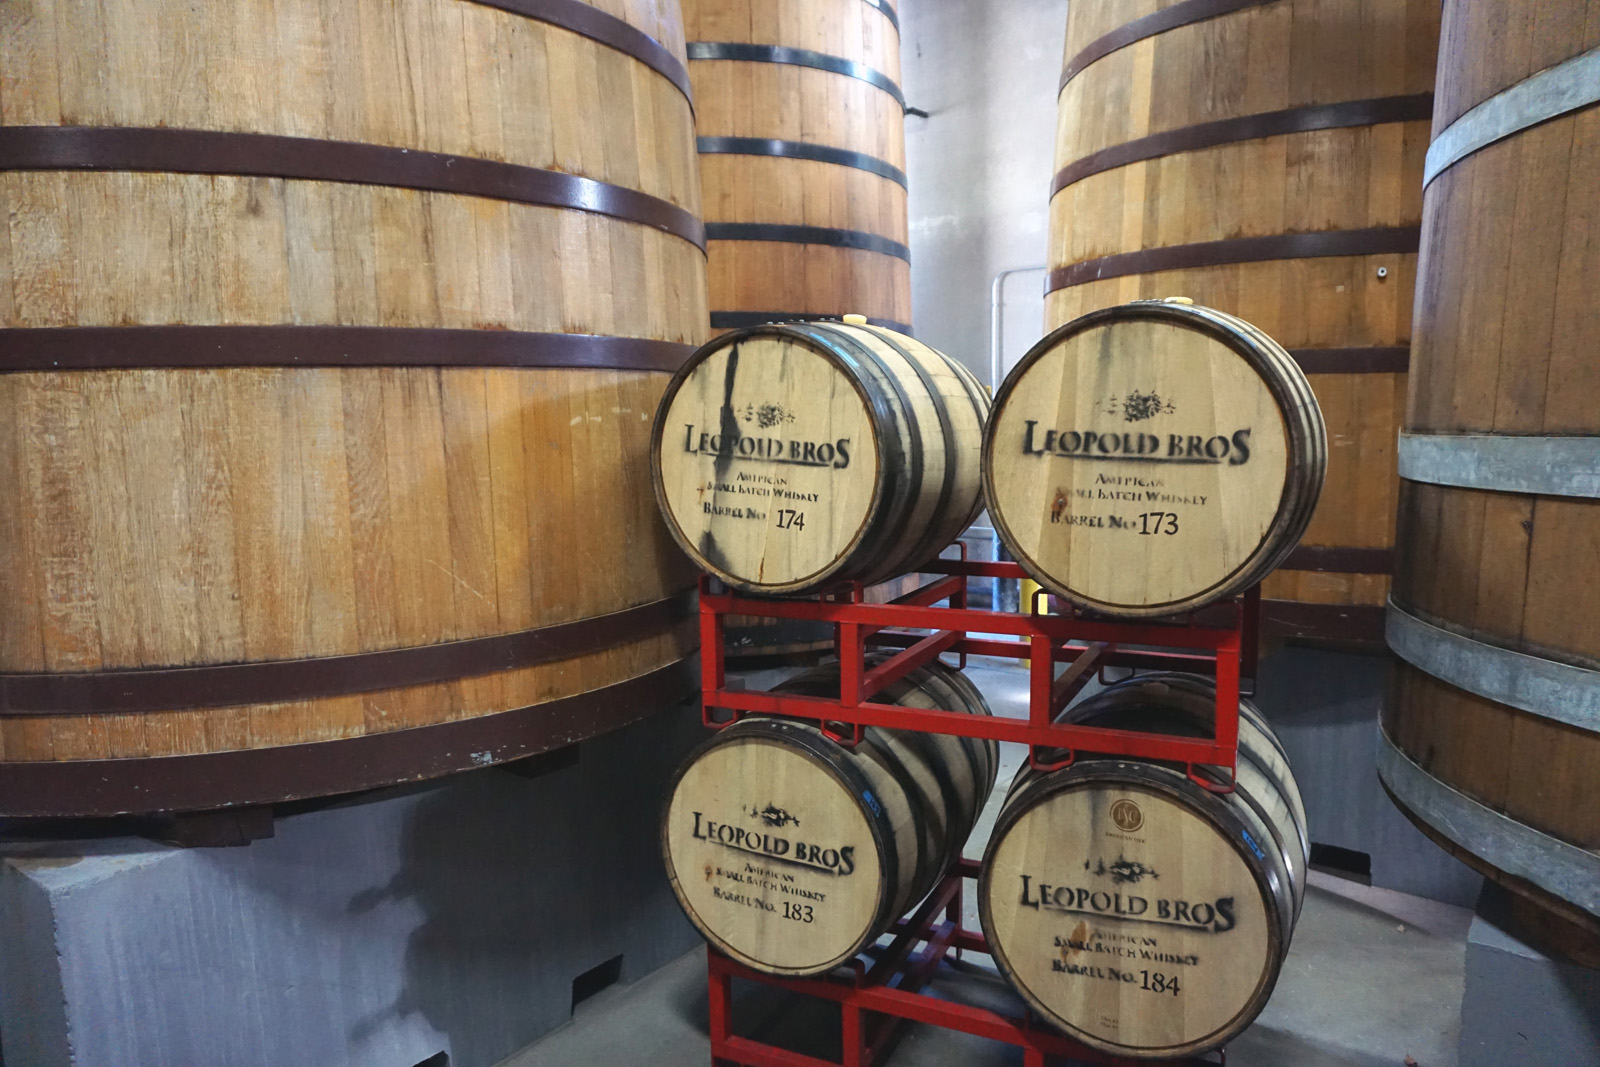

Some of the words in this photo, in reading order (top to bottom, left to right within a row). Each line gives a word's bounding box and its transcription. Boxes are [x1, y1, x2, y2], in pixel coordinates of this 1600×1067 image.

[790, 438, 850, 469] BROS
[1022, 420, 1160, 458] LEOPOLD
[1167, 427, 1251, 466] BROS
[776, 509, 805, 531] 174
[1138, 512, 1179, 535] 173
[692, 811, 790, 856] LEOPOLD
[795, 842, 855, 877] BROS
[782, 901, 815, 923] 183
[1019, 874, 1148, 915] LEOPOLD
[1157, 896, 1235, 934] BROS
[1140, 970, 1181, 997] 184
